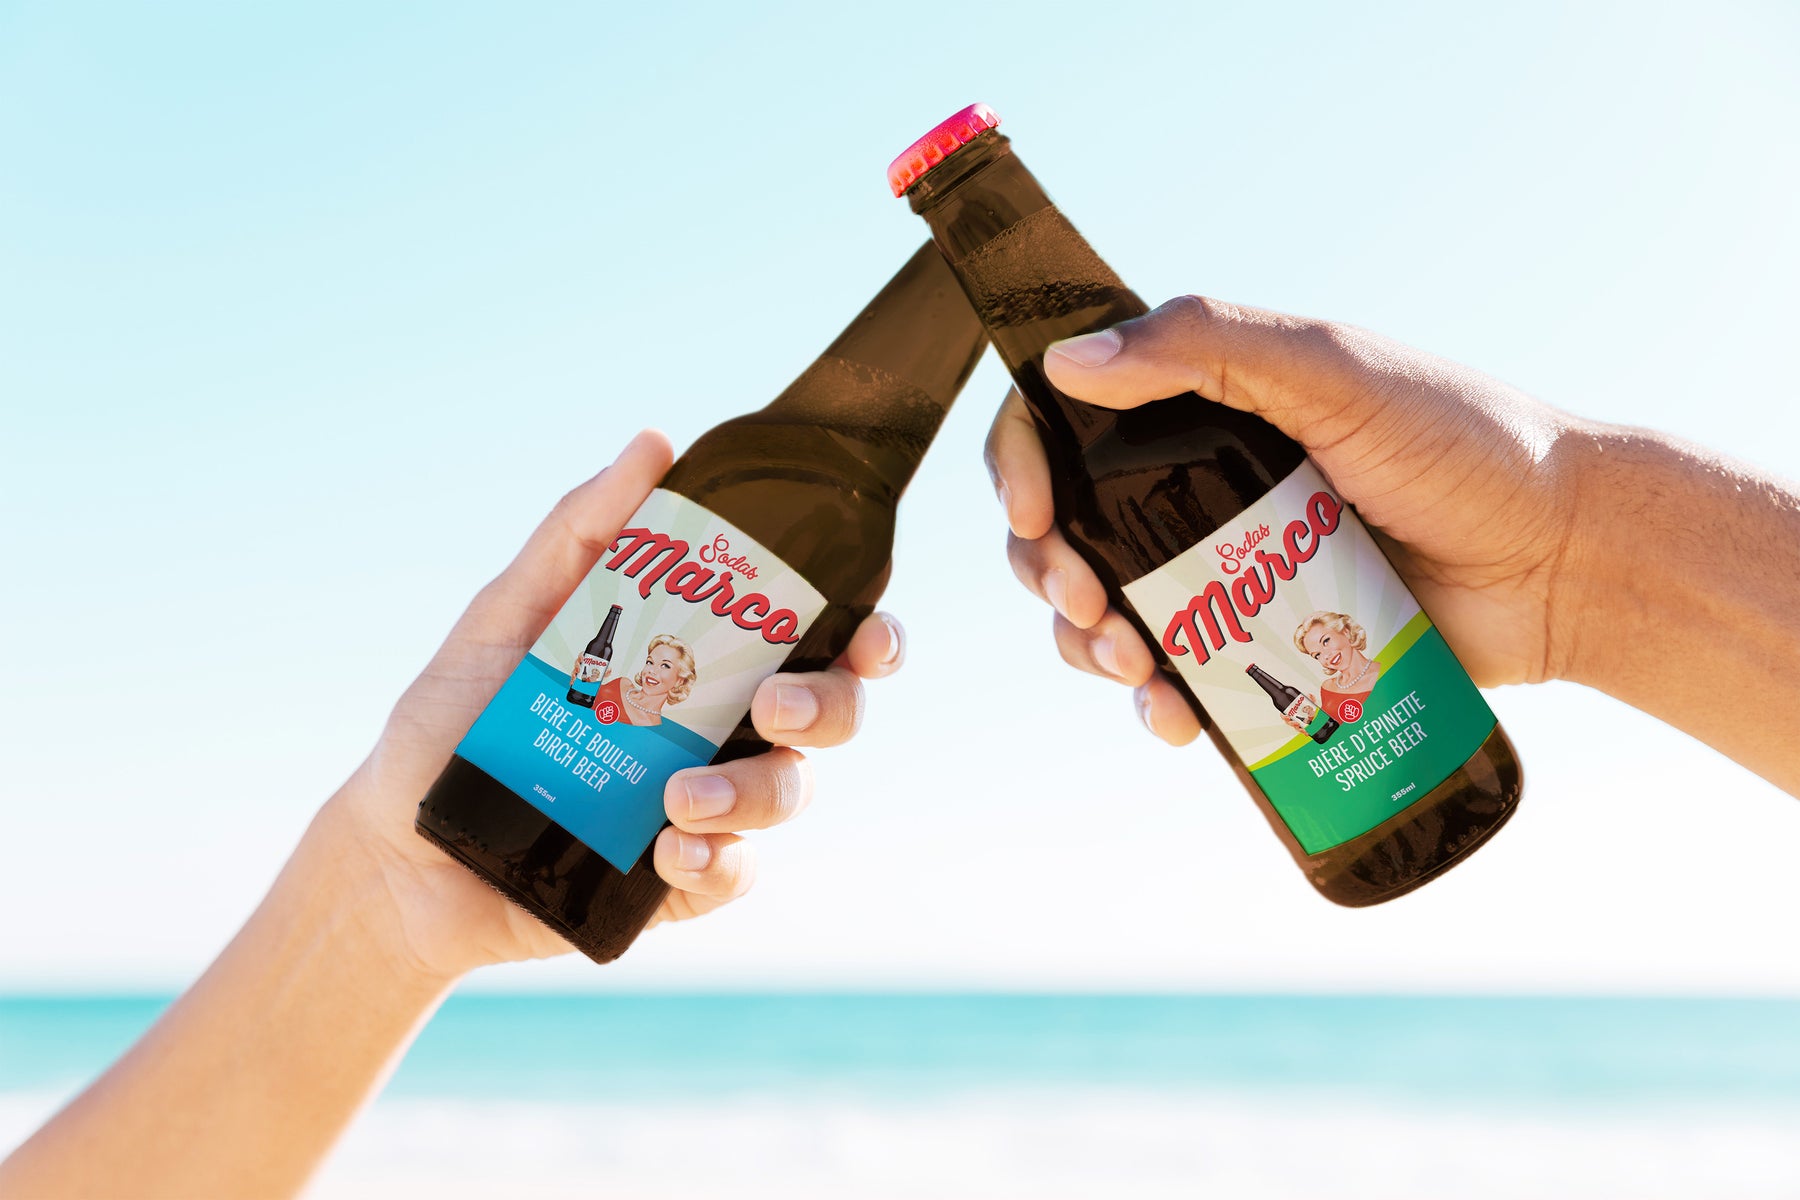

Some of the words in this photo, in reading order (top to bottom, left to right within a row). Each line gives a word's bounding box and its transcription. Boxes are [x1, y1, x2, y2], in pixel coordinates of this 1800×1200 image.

[699, 534, 758, 580] Sodas
[1162, 491, 1343, 666] Marco
[1215, 523, 1271, 575] Sodas
[605, 528, 800, 645] Marco
[530, 692, 573, 731] BIÈRE
[566, 718, 592, 745] DE
[585, 732, 648, 785] BOULEAU
[533, 728, 578, 768] BIRCH
[572, 755, 611, 793] BEER
[1308, 740, 1355, 778] BIÈRE
[1349, 690, 1426, 754] D'ÉPINETTE
[1335, 746, 1393, 792] SPRUCE
[1387, 721, 1428, 758] BEER
[533, 784, 556, 803] 355ml
[1391, 782, 1416, 802] 355ml
